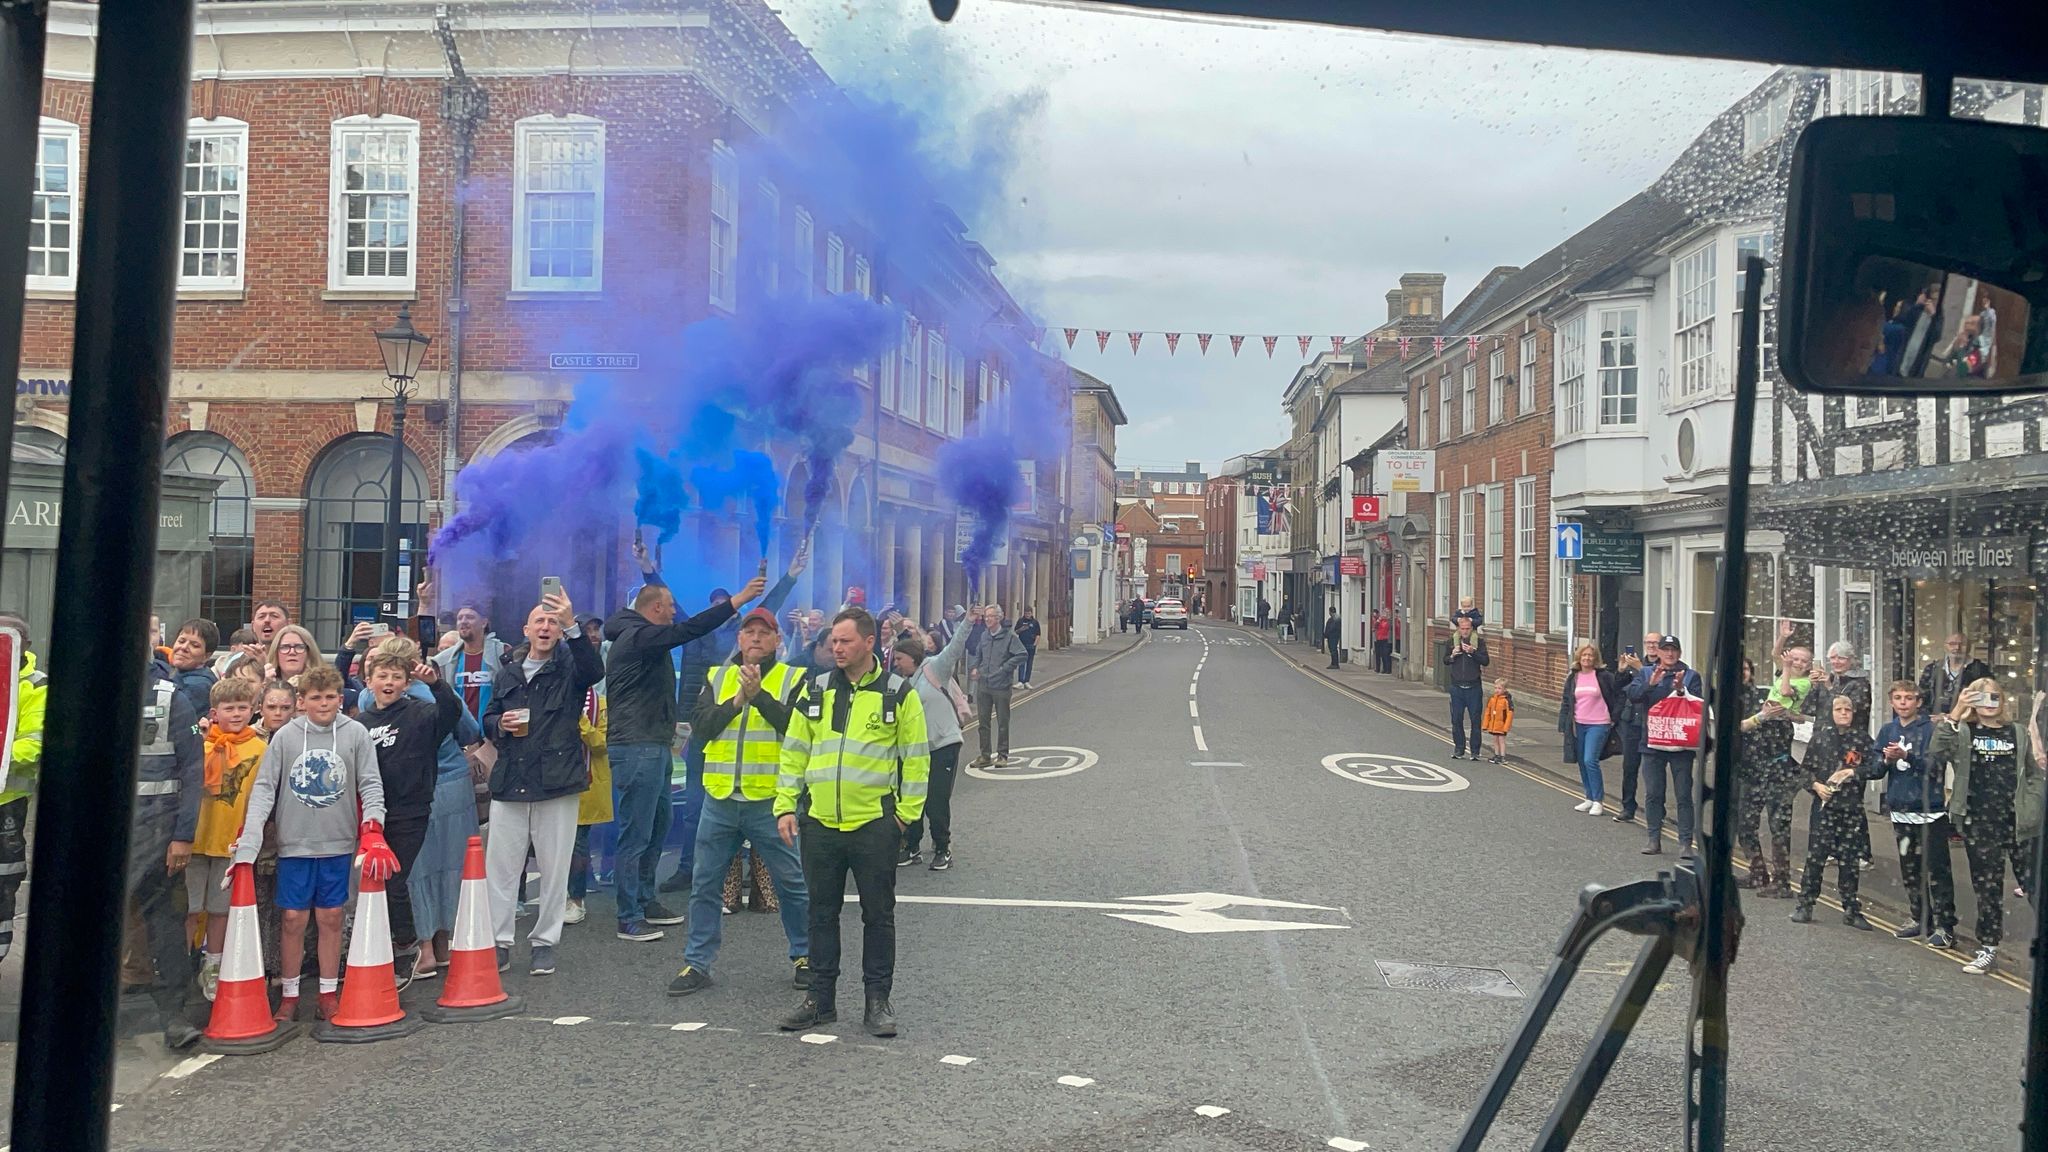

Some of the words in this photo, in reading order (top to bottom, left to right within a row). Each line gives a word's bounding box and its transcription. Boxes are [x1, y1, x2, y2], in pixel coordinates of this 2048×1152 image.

[554, 356, 593, 366] CASTLE
[596, 356, 634, 366] STREET
[1386, 460, 1402, 469] TO
[1406, 460, 1427, 469] LET
[1252, 472, 1272, 480] BUSH
[1620, 538, 1641, 546] YARD
[1891, 544, 1947, 567] between
[1952, 542, 1975, 567] the
[1979, 542, 2013, 567] lines
[382, 735, 397, 748] SB
[1346, 763, 1447, 781] 20
